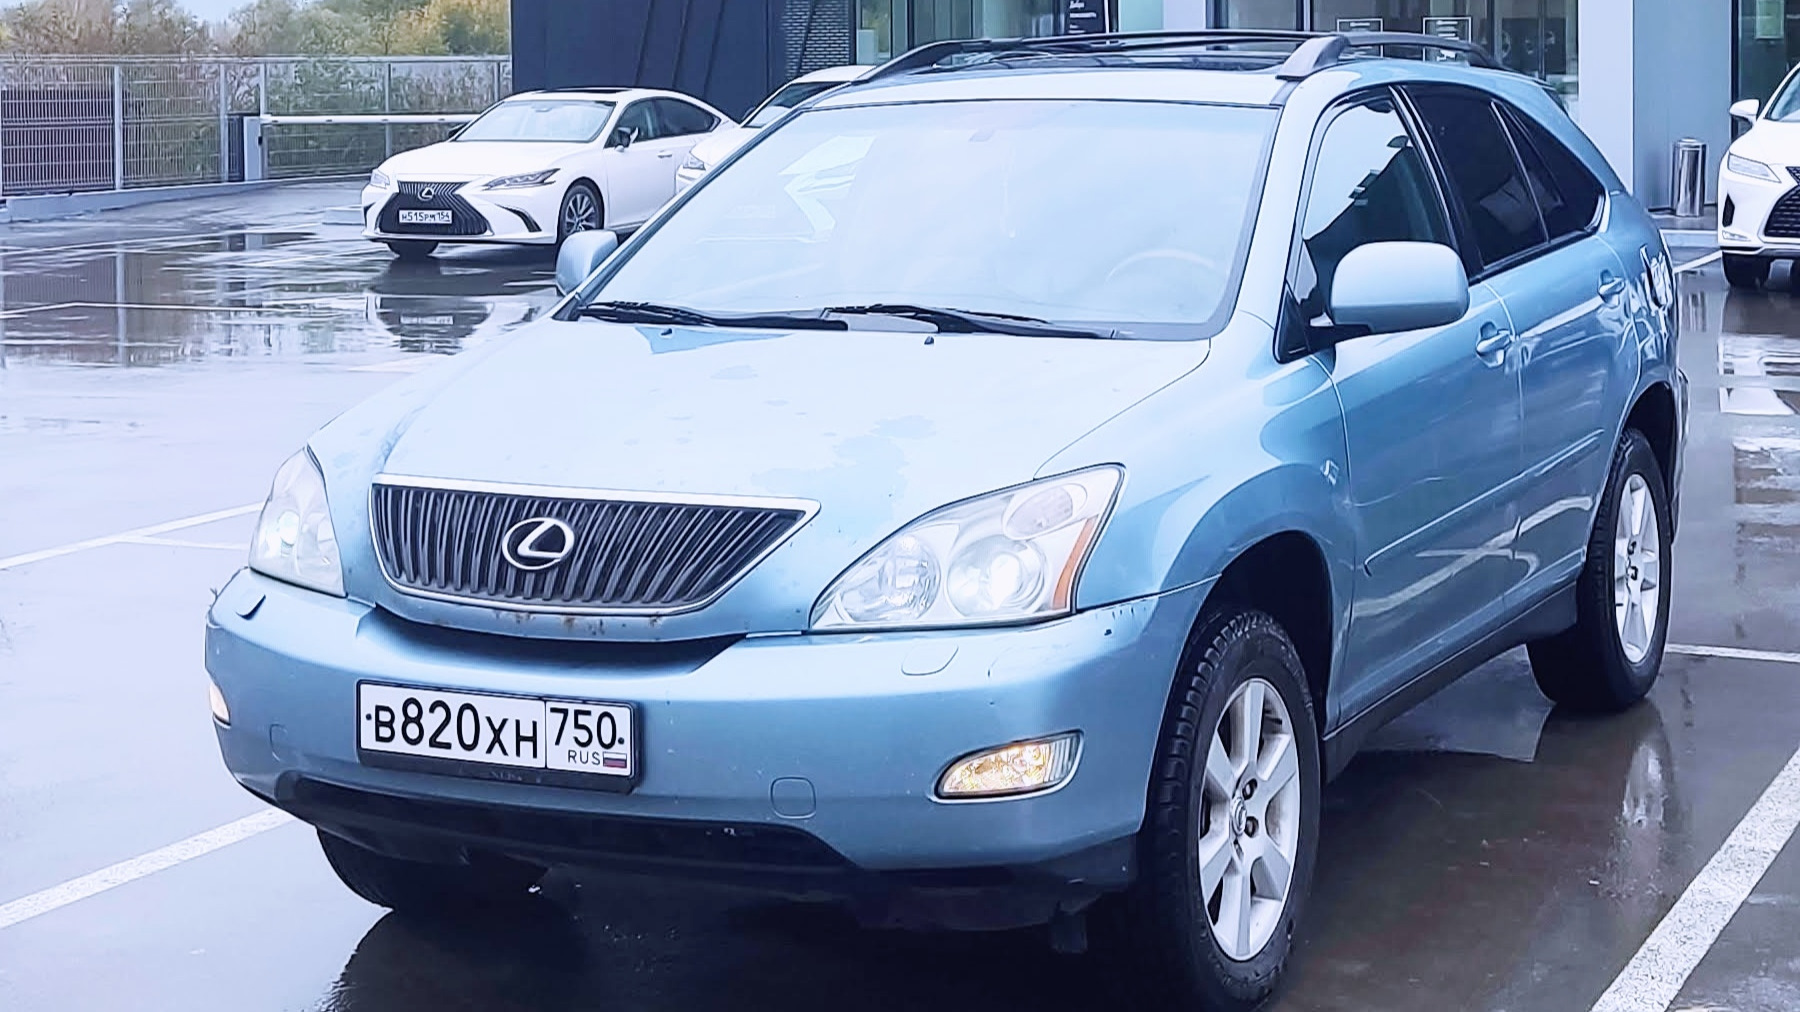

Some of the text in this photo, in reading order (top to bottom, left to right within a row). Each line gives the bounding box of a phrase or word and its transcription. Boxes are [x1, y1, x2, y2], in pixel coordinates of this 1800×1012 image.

[374, 697, 617, 759] В820ХН 750
[567, 750, 601, 765] RUS
